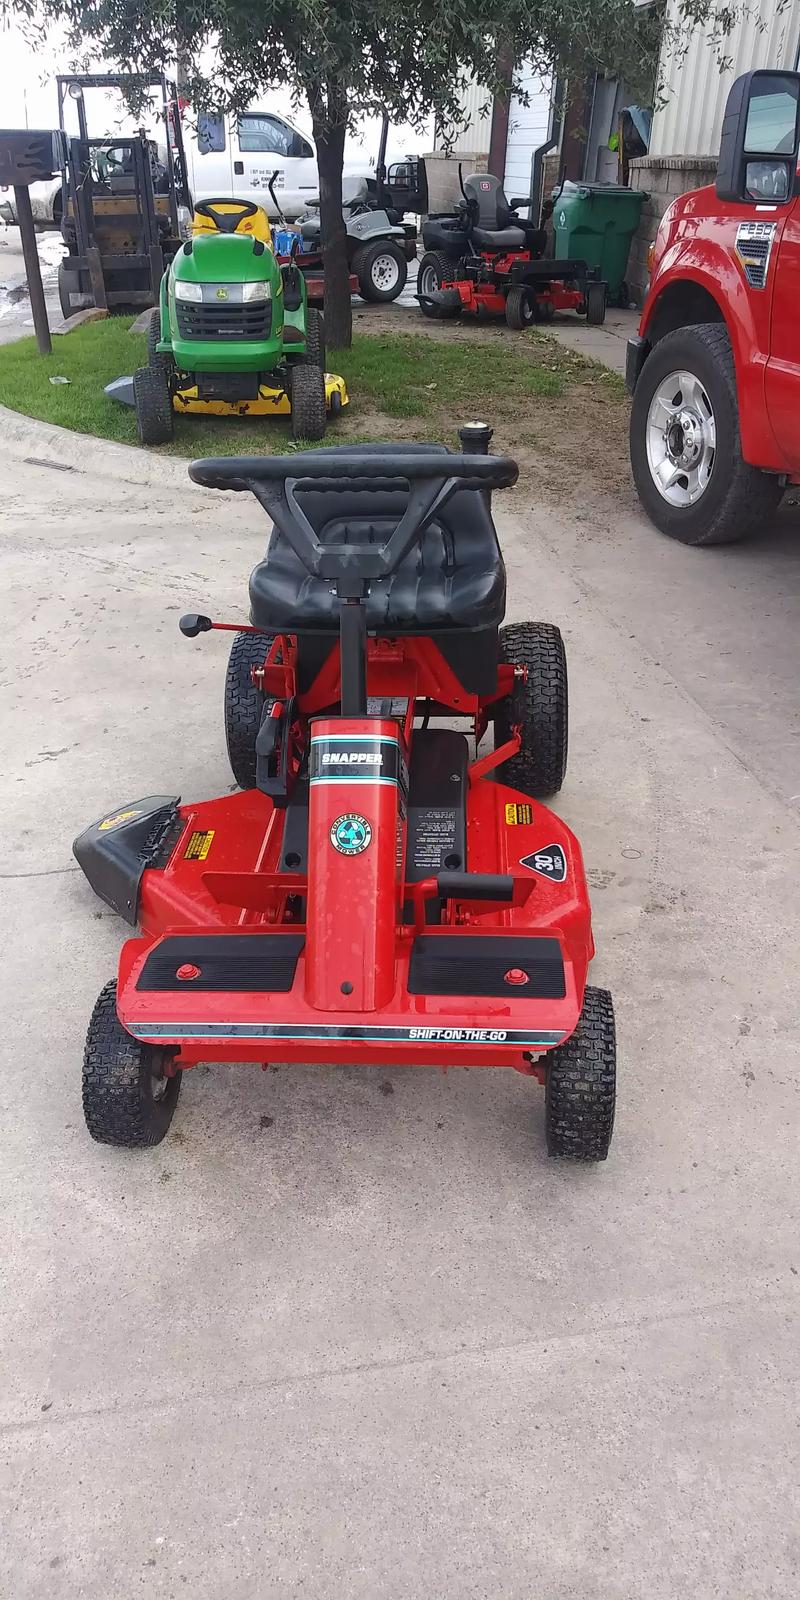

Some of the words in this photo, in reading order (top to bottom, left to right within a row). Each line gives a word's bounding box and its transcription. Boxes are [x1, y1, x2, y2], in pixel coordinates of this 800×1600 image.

[322, 753, 383, 765] SNAPPER
[331, 814, 371, 835] CONVERTIBLE
[336, 845, 366, 854] MOWER
[534, 854, 554, 871] 30
[553, 855, 563, 870] INCH
[409, 1029, 507, 1041] SHIFT-ON-THE-GO
